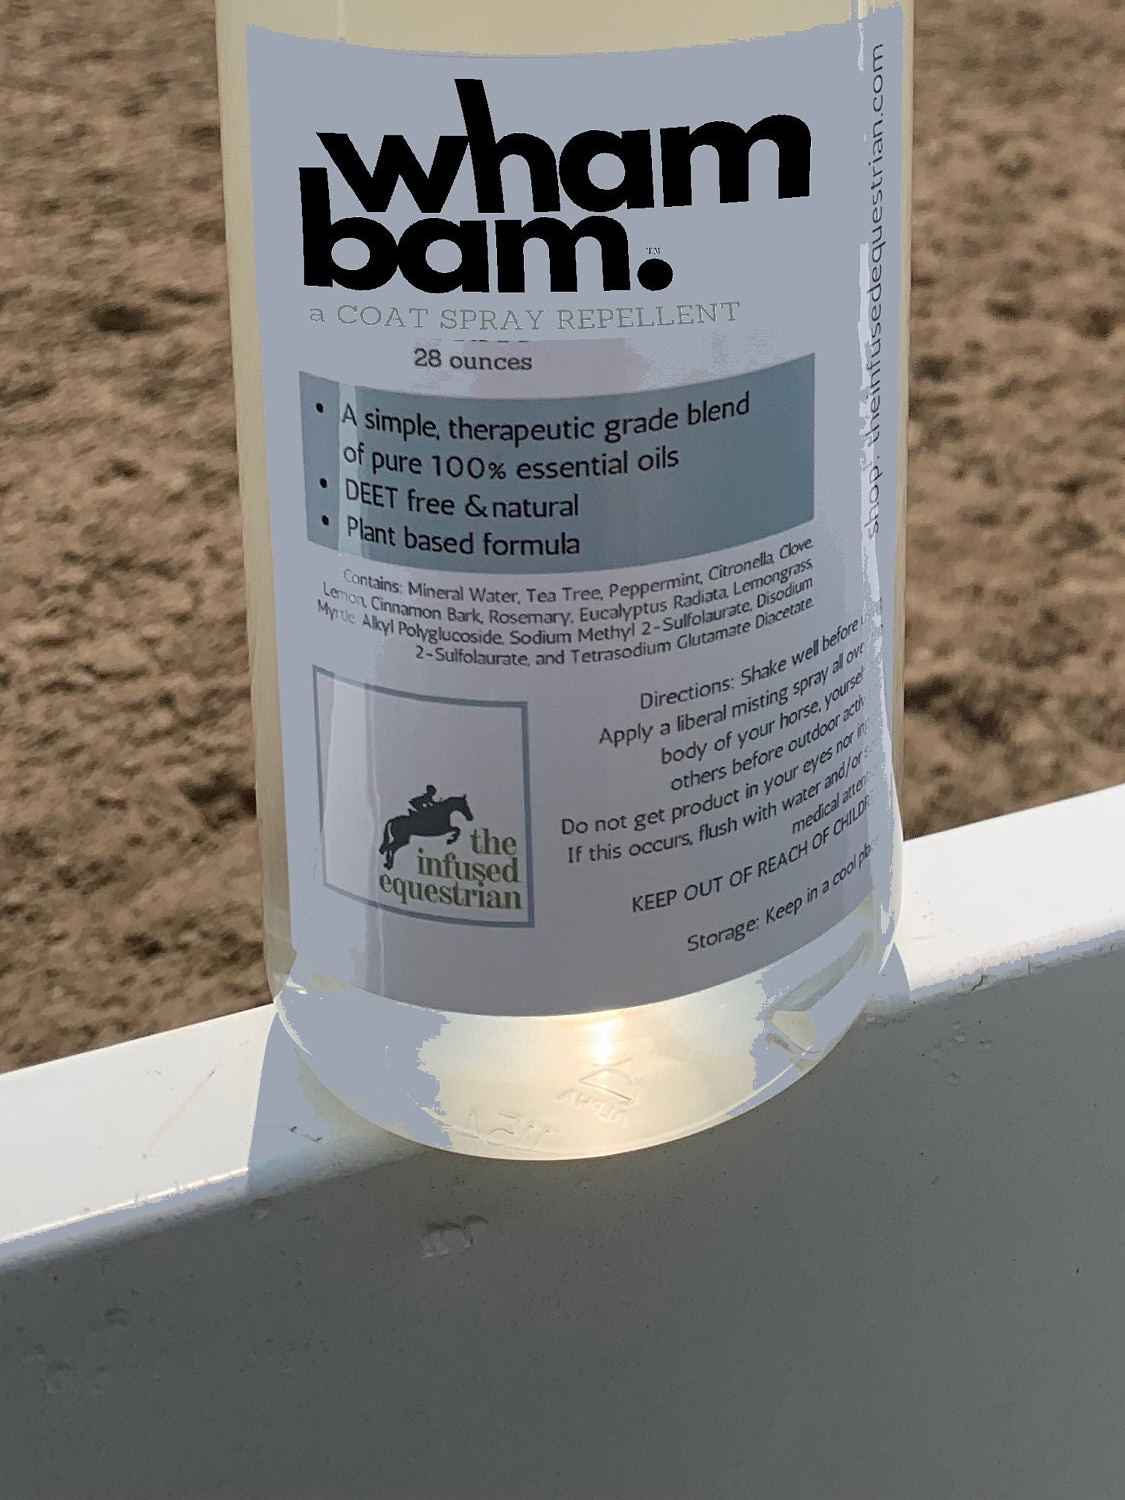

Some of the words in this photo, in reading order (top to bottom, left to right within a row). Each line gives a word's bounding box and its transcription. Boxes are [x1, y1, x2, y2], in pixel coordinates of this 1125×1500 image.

[316, 78, 812, 214] wham
[309, 308, 326, 323] a
[337, 305, 429, 328] COAT
[440, 308, 545, 331] SPRAY
[557, 301, 741, 330] REPELLENT
[414, 348, 442, 368] 28
[449, 355, 533, 371] ounces
[341, 403, 357, 426] A
[365, 408, 440, 441] simple,
[449, 416, 595, 447] therapeutic
[604, 407, 679, 443] grade
[687, 390, 750, 426] blend
[343, 442, 365, 465] of
[372, 451, 422, 475] pure
[432, 455, 506, 479] 100%
[516, 449, 629, 479] essential
[637, 445, 680, 472] oils
[345, 478, 398, 509] DEET
[407, 489, 455, 516] free
[347, 515, 396, 547] Plant
[404, 526, 474, 555] based
[483, 532, 580, 556] formula
[343, 568, 402, 594] Contains:
[408, 581, 464, 601] Mineral
[526, 588, 557, 603] Tea
[609, 573, 703, 600] Peppermint,
[371, 596, 441, 620] Cinnamon
[448, 607, 484, 625] Bark,
[580, 600, 667, 622] Eucalyptus
[673, 588, 729, 609] Radiata,
[734, 558, 813, 596] Lemongrass,
[362, 613, 394, 636] Alkyl
[510, 630, 572, 645] Sodium
[578, 623, 635, 642] Methyl
[757, 577, 813, 609] Disodium
[536, 650, 565, 666] and
[571, 640, 672, 664] Tetrasodium
[677, 621, 751, 650] Glutamate
[640, 678, 735, 711] Directions:
[741, 658, 787, 687] Shake
[791, 640, 819, 666] well
[823, 620, 859, 652] before
[599, 723, 654, 748] Apply
[660, 722, 671, 737] a
[677, 708, 727, 733] liberal
[732, 686, 788, 718] misting
[793, 666, 829, 697] spray
[832, 652, 844, 674] all
[661, 739, 708, 765] body
[714, 735, 733, 752] of
[737, 722, 775, 749] your
[670, 765, 727, 791] others
[733, 744, 784, 775] before
[789, 714, 840, 752] outdoor
[562, 817, 588, 837] Do
[595, 814, 627, 832] not
[634, 809, 665, 834] get
[672, 788, 739, 825] product
[746, 781, 759, 799] in
[764, 768, 799, 797] your
[803, 751, 833, 777] eyes
[837, 731, 854, 760] nor
[568, 847, 582, 863] If
[589, 845, 621, 862] this
[629, 834, 693, 857] occurs,
[699, 817, 737, 842] flush
[743, 803, 777, 828] with
[782, 780, 821, 811] water
[824, 750, 863, 789] and/or
[792, 792, 839, 834] medical
[470, 828, 517, 855] the
[417, 848, 521, 883] infused
[632, 889, 677, 913] KEEP
[684, 876, 722, 901] OUT
[729, 865, 754, 887] OF
[757, 843, 808, 878] REACH
[812, 827, 830, 850] OF
[379, 873, 522, 910] equestrian
[688, 918, 759, 952] Storage:
[766, 896, 803, 924] Keep
[806, 886, 819, 903] in
[822, 880, 829, 894] a
[833, 854, 856, 886] cool
